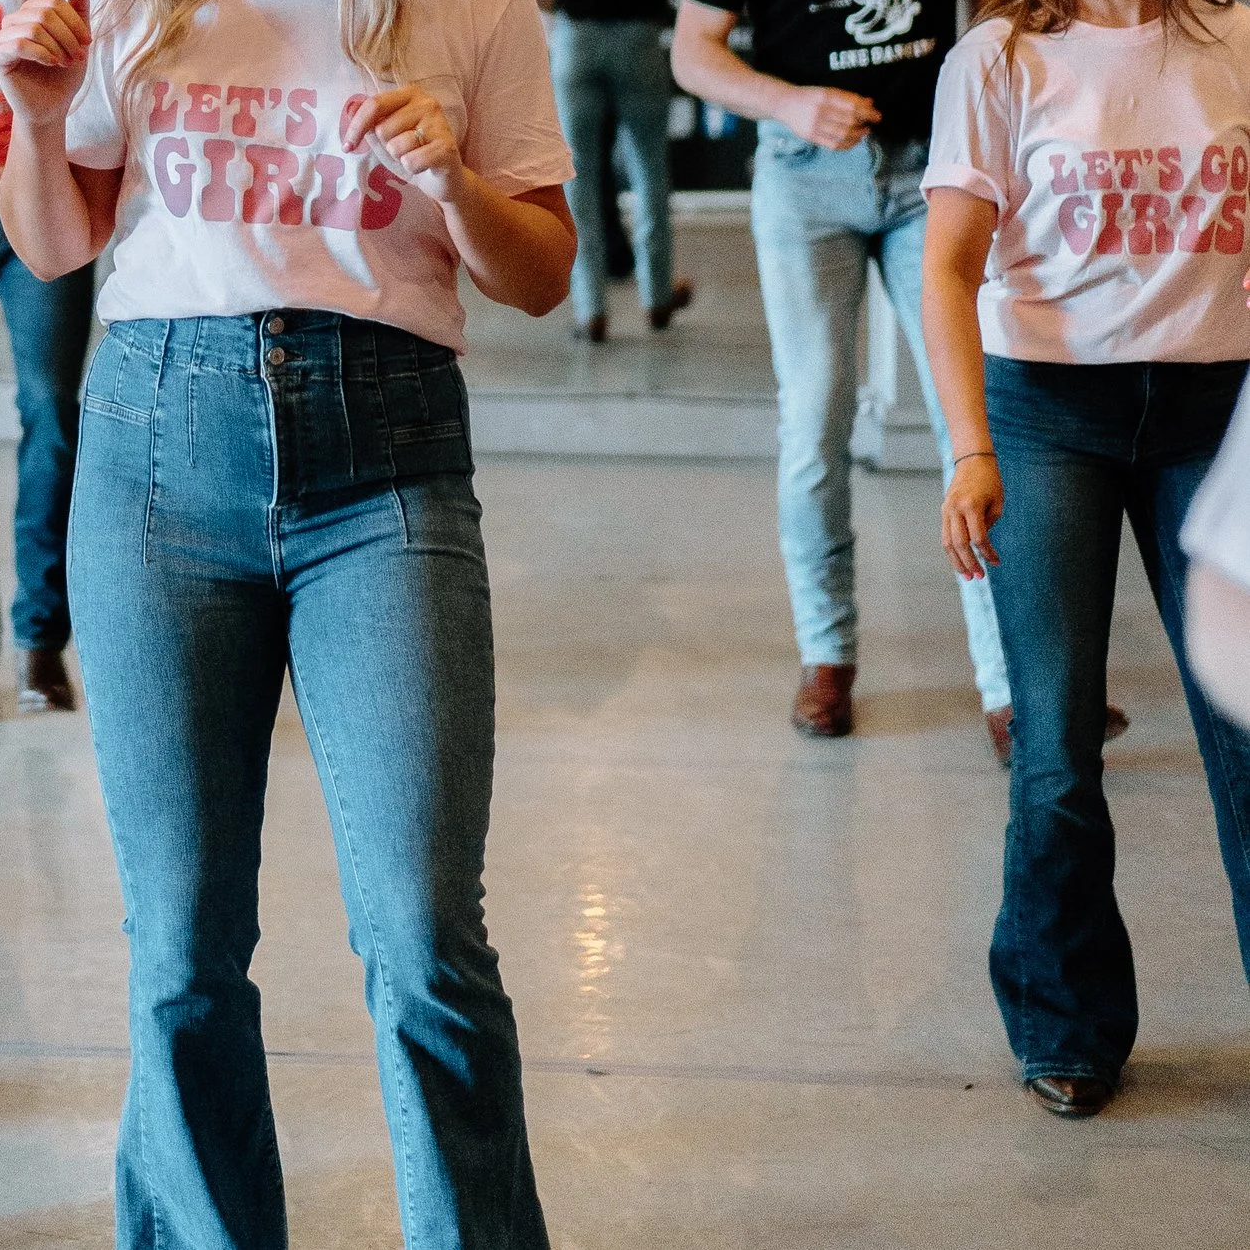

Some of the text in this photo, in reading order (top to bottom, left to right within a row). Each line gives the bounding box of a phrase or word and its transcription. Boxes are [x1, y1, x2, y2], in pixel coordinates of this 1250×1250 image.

[149, 81, 317, 147] LET'S
[154, 136, 407, 231] GIRLS
[1050, 145, 1248, 195] LET'S GO
[1058, 194, 1246, 255] GIRLS
